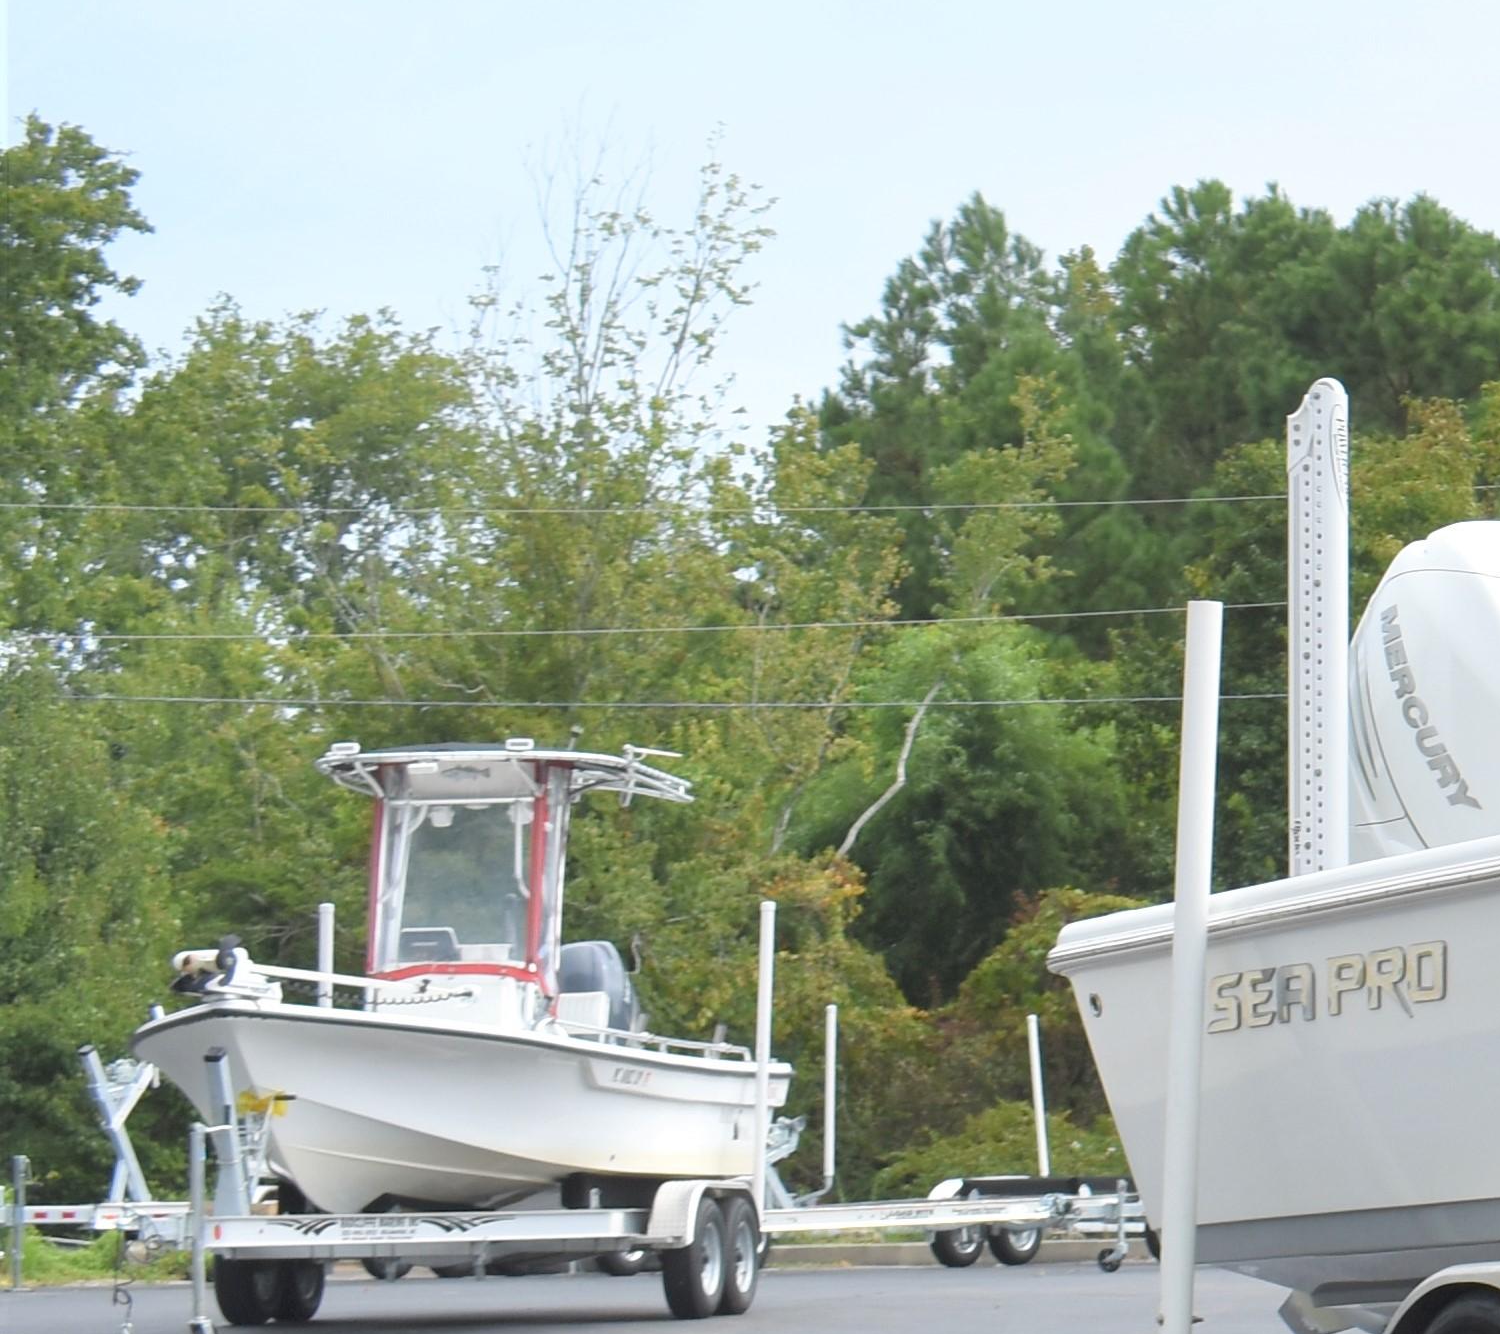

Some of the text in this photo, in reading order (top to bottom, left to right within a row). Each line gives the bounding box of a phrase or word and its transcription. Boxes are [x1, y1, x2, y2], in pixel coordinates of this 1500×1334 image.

[1380, 604, 1483, 810] MERCURY
[1207, 940, 1448, 1035] SEA PRO
